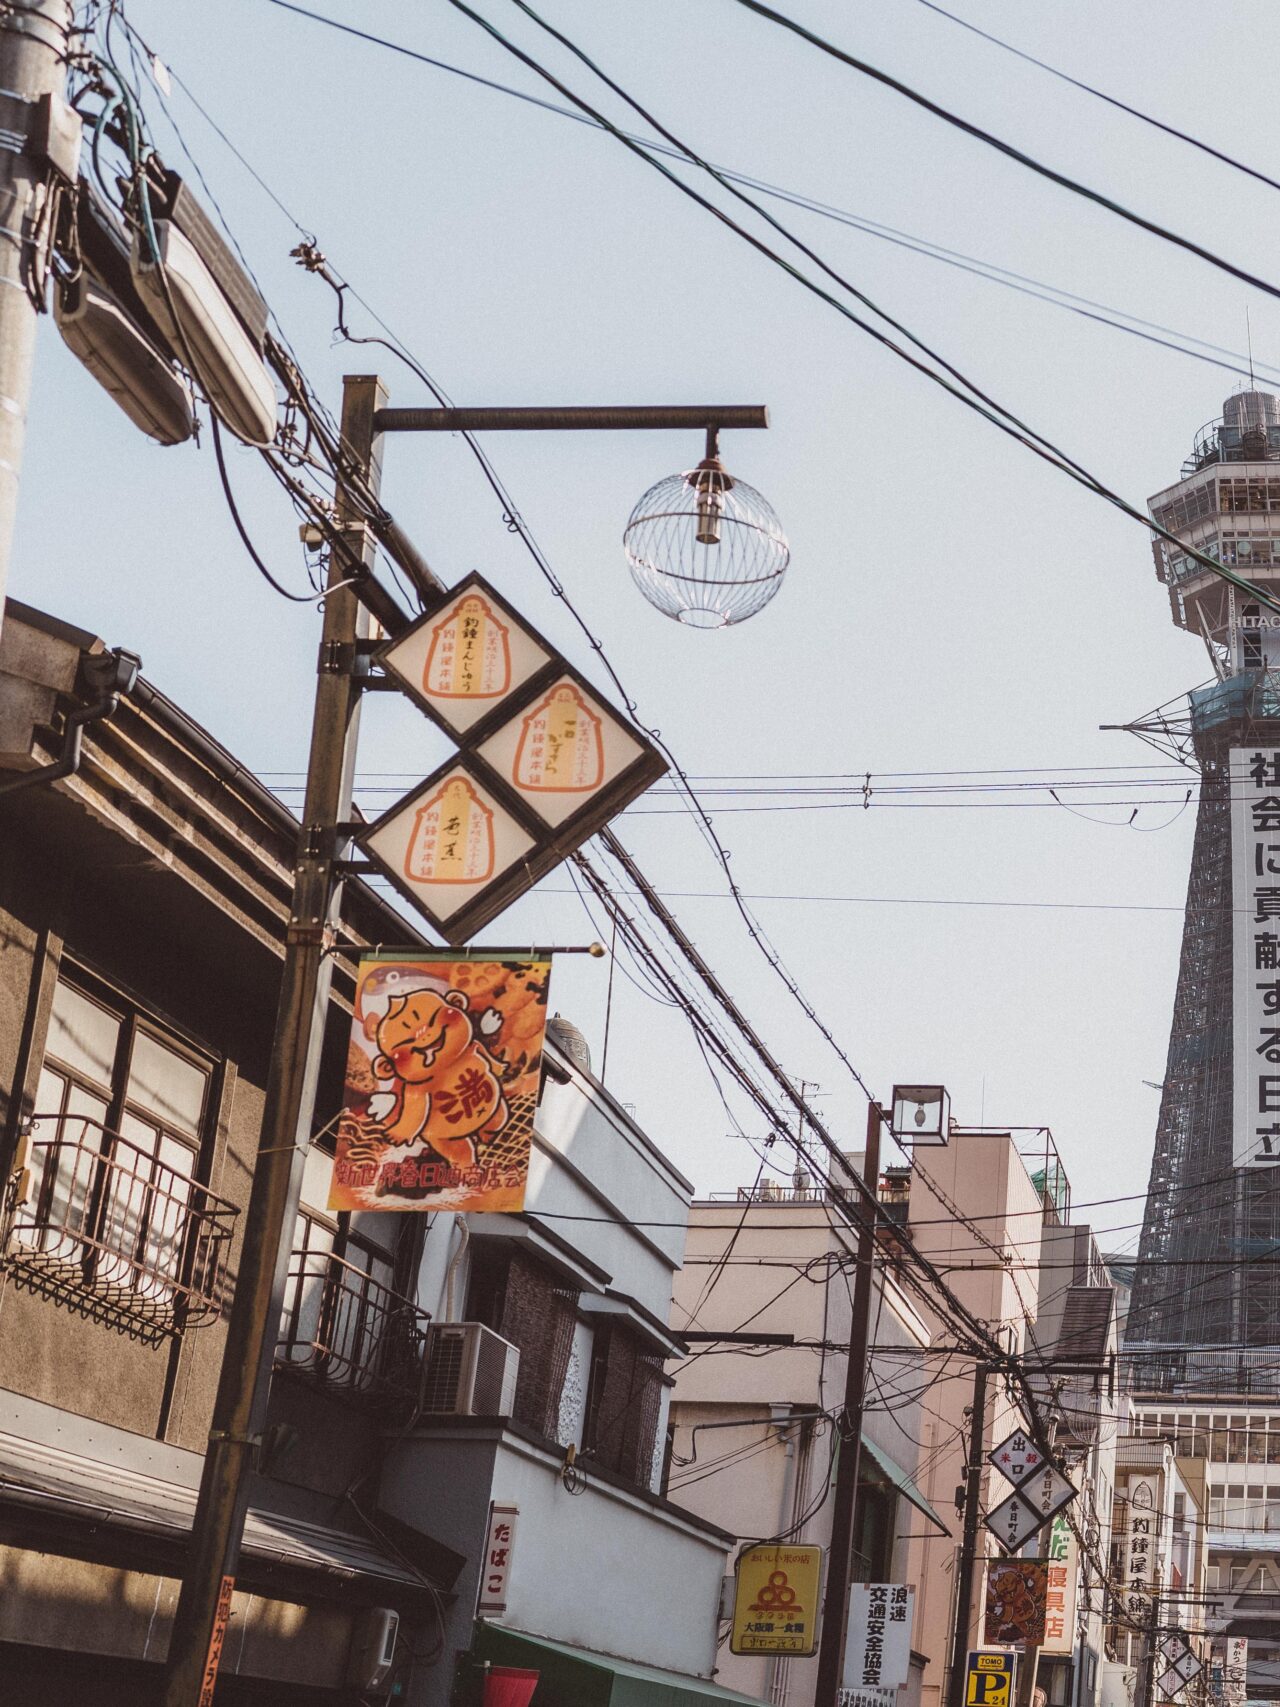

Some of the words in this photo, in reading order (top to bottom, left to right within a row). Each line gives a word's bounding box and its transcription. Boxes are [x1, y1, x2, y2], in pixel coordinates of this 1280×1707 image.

[1042, 1469, 1053, 1510] 春日町会
[1008, 1501, 1019, 1542] 春日町会
[488, 1524, 510, 1593] たばこ
[889, 1587, 907, 1622] 浪速
[862, 1587, 888, 1685] 交通安全協会
[969, 1672, 1007, 1704] P
[992, 1696, 1005, 1705] 24
